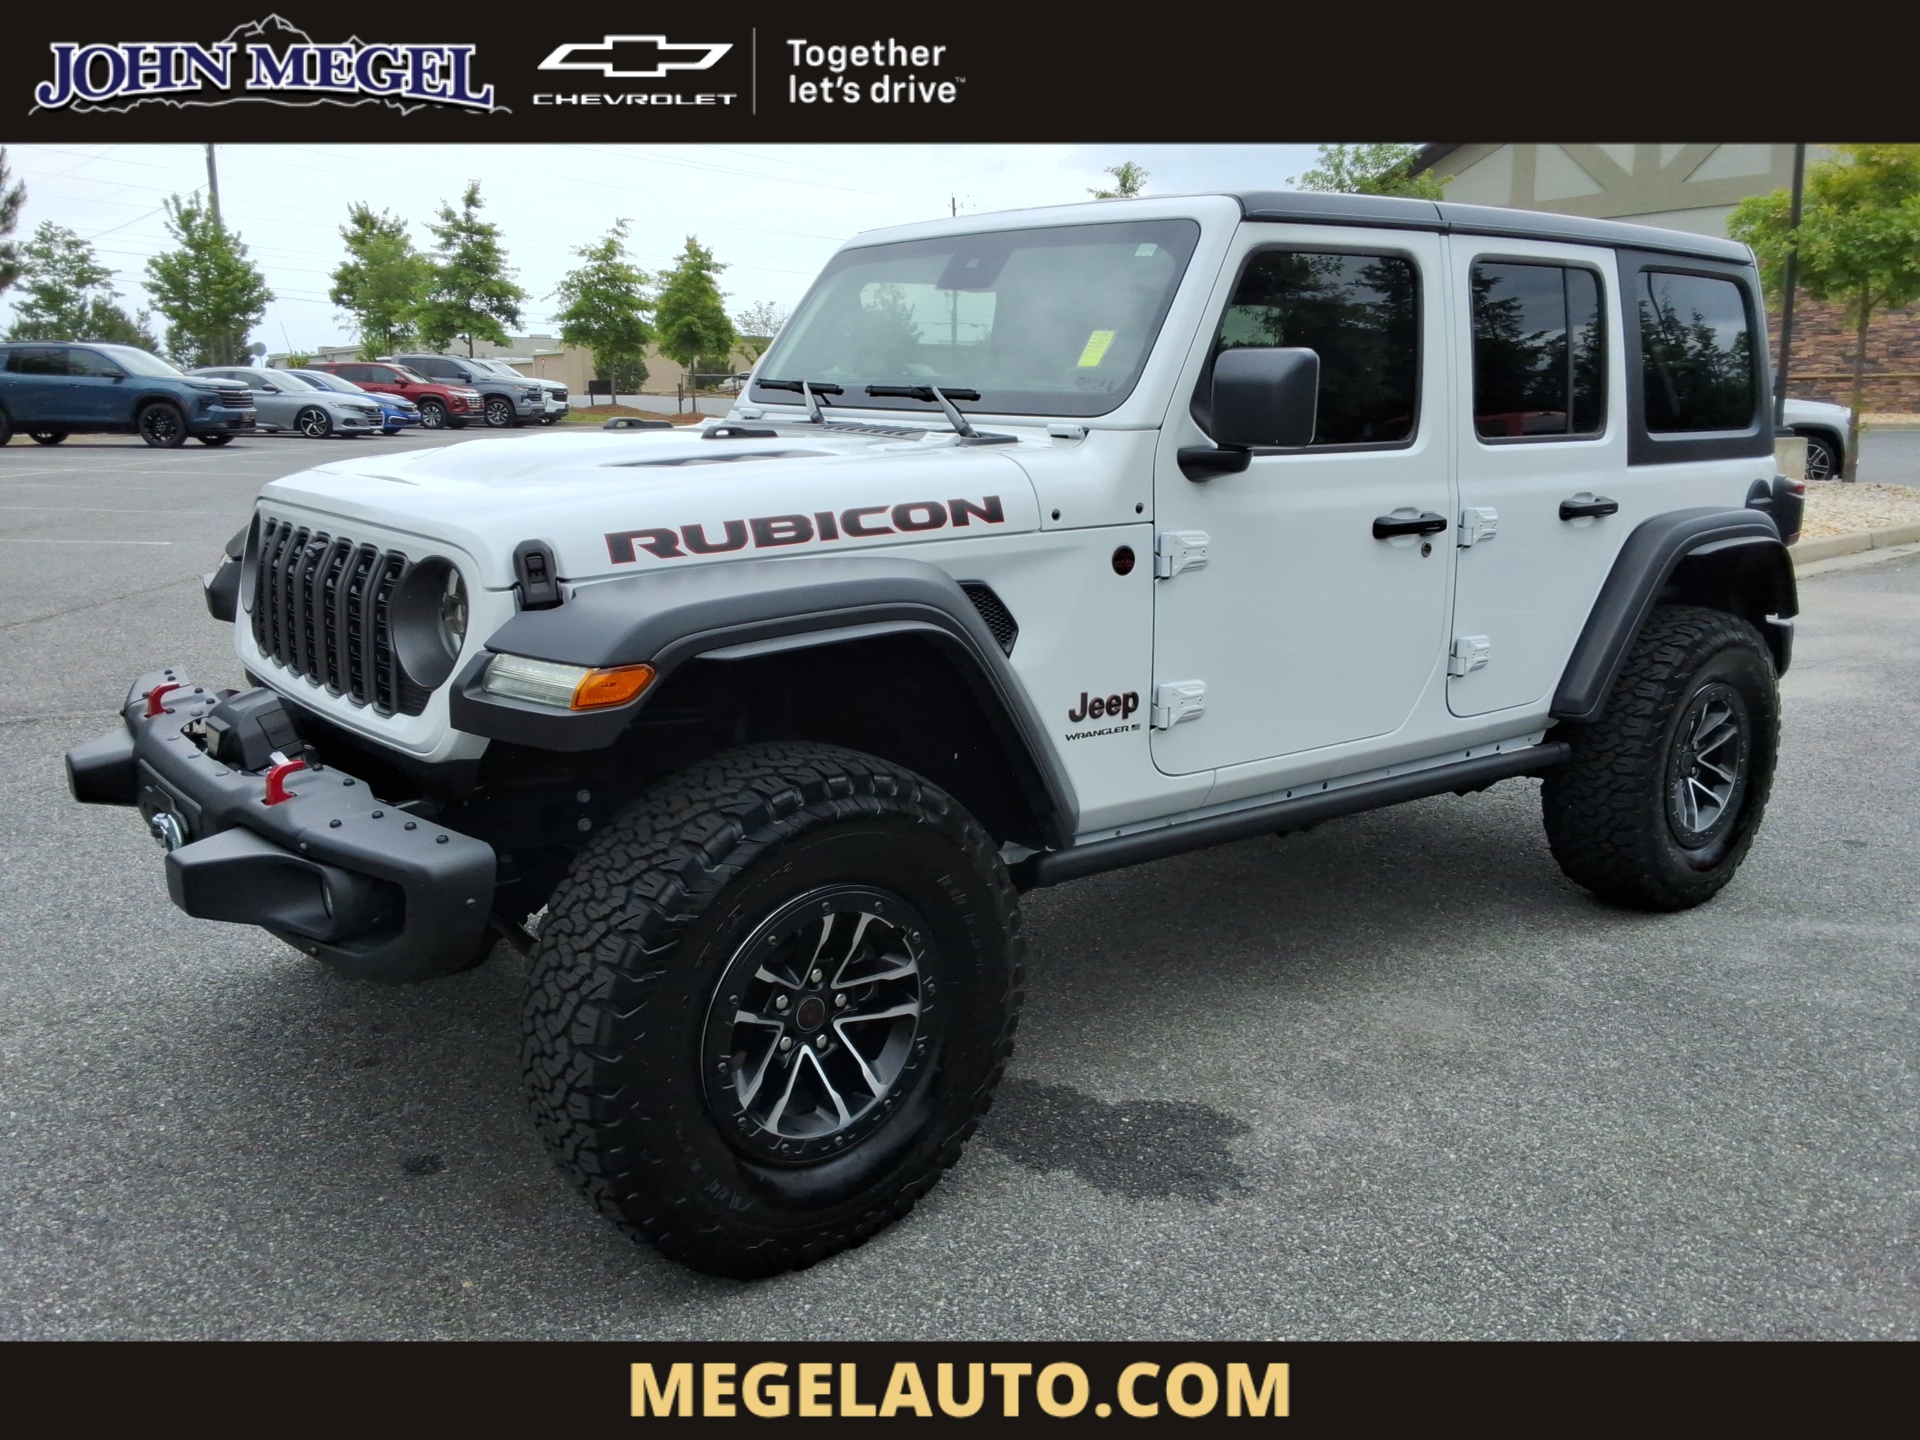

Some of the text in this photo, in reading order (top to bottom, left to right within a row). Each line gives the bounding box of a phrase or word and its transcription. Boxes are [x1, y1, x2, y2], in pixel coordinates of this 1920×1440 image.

[604, 495, 1005, 565] RUBICON
[1068, 690, 1140, 723] Jeep
[1065, 724, 1131, 742] WRANGLER
